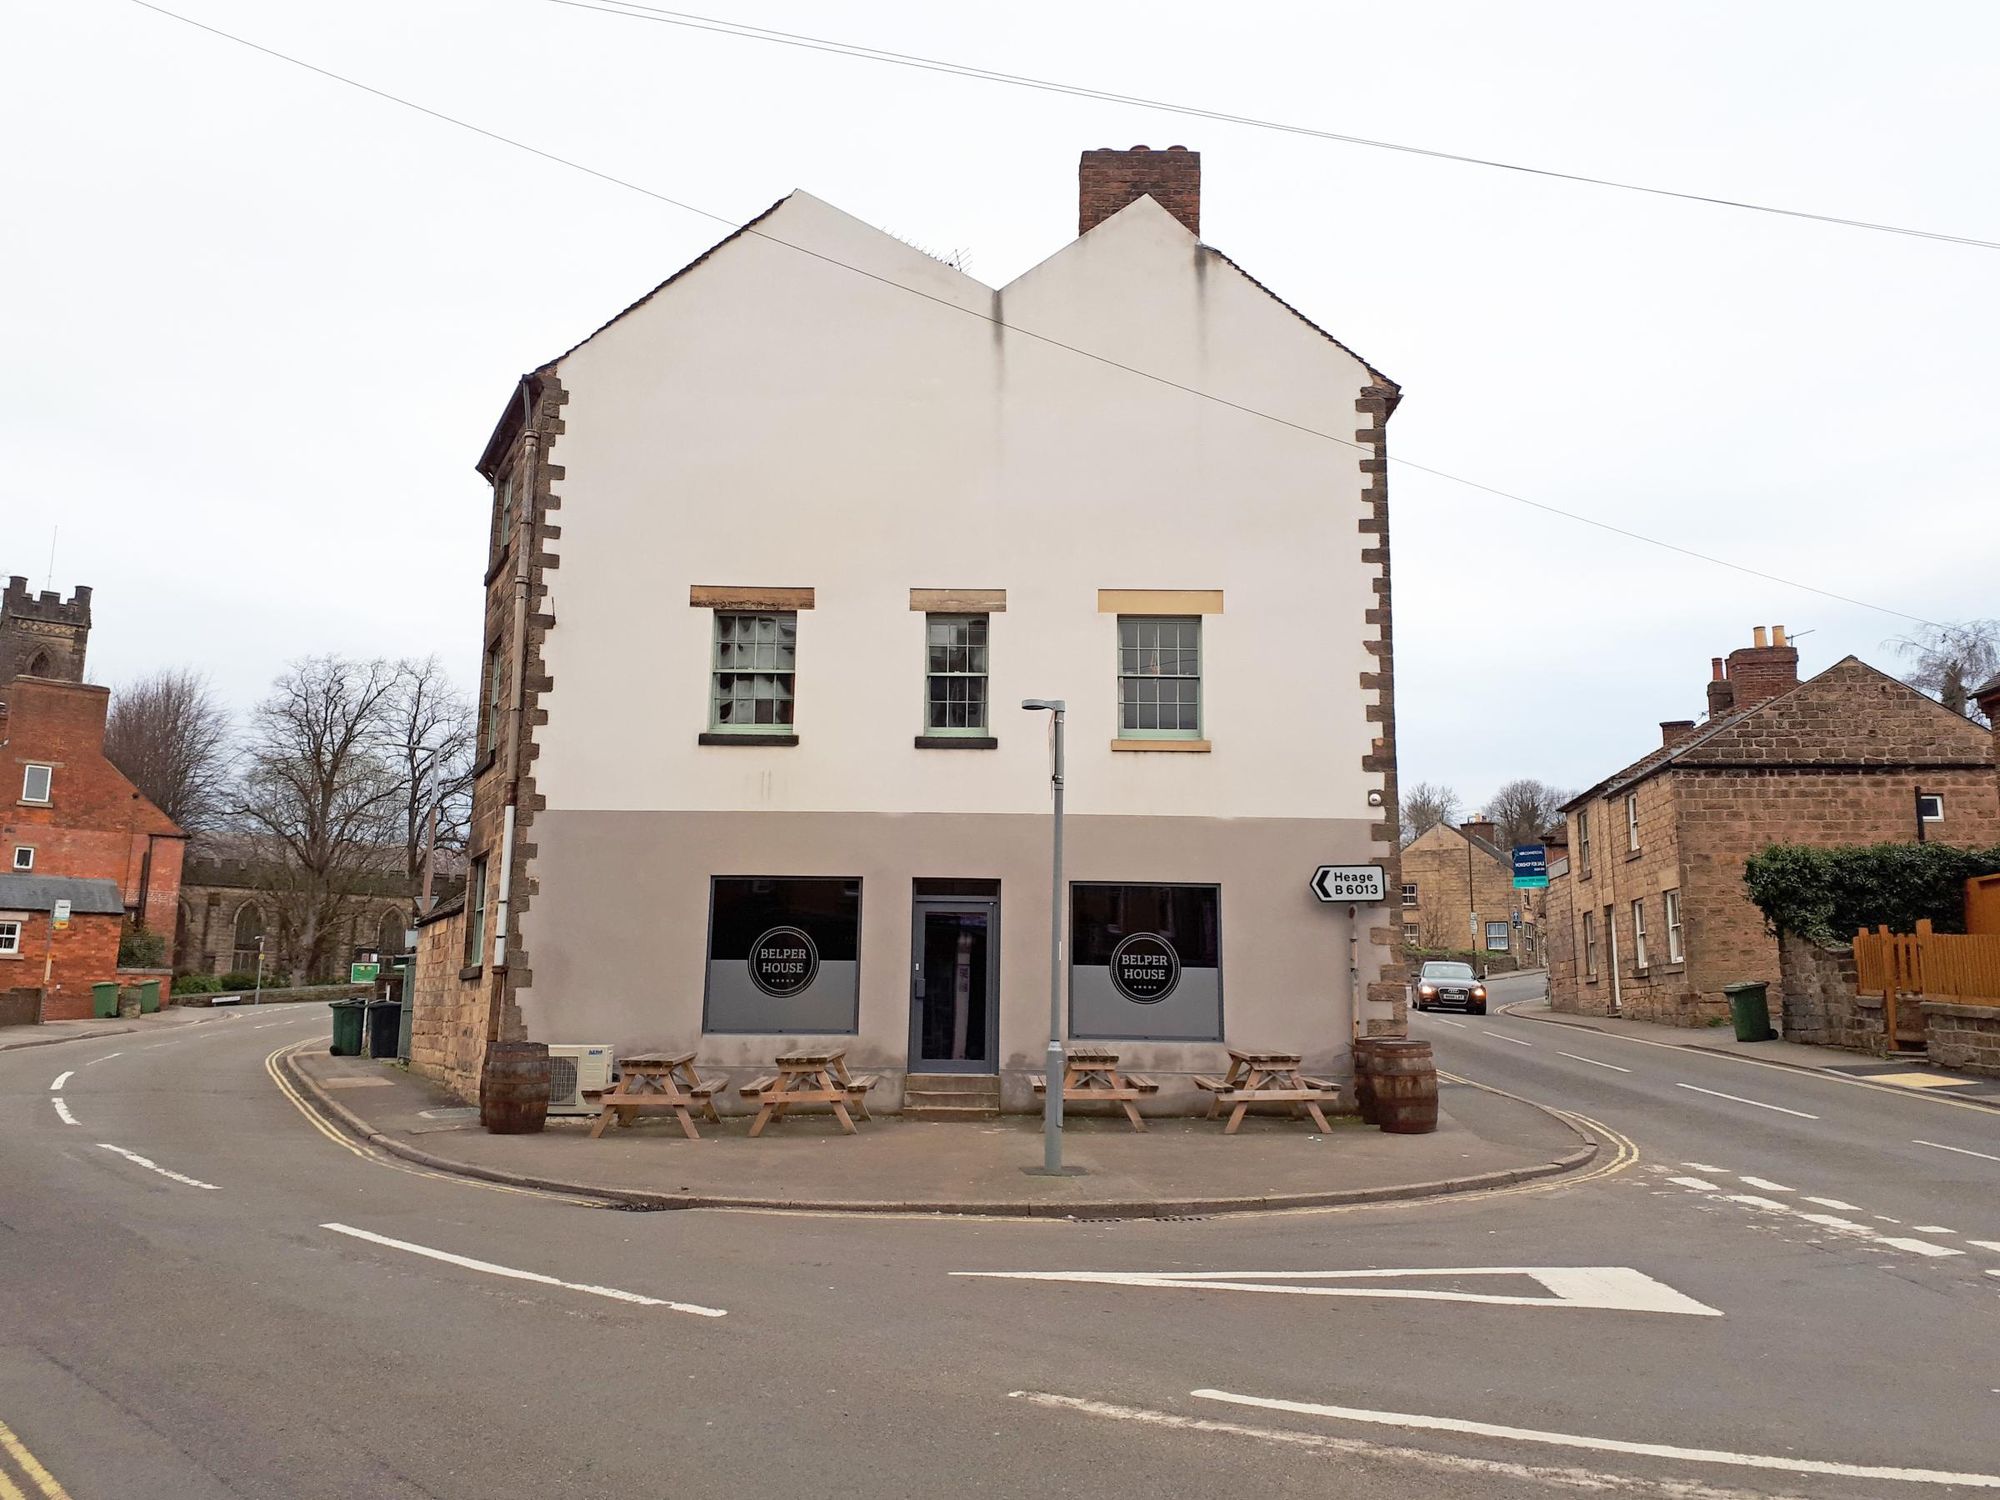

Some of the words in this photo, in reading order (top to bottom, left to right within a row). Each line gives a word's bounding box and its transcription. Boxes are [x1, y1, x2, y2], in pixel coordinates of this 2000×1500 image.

[1334, 872, 1374, 884] Heage
[1335, 884, 1344, 895] B
[1346, 884, 1379, 895] 6013
[760, 948, 807, 959] BELPER
[1121, 954, 1168, 966] BELPER
[762, 962, 804, 973] HOUSE
[1123, 968, 1166, 980] HOUSE
